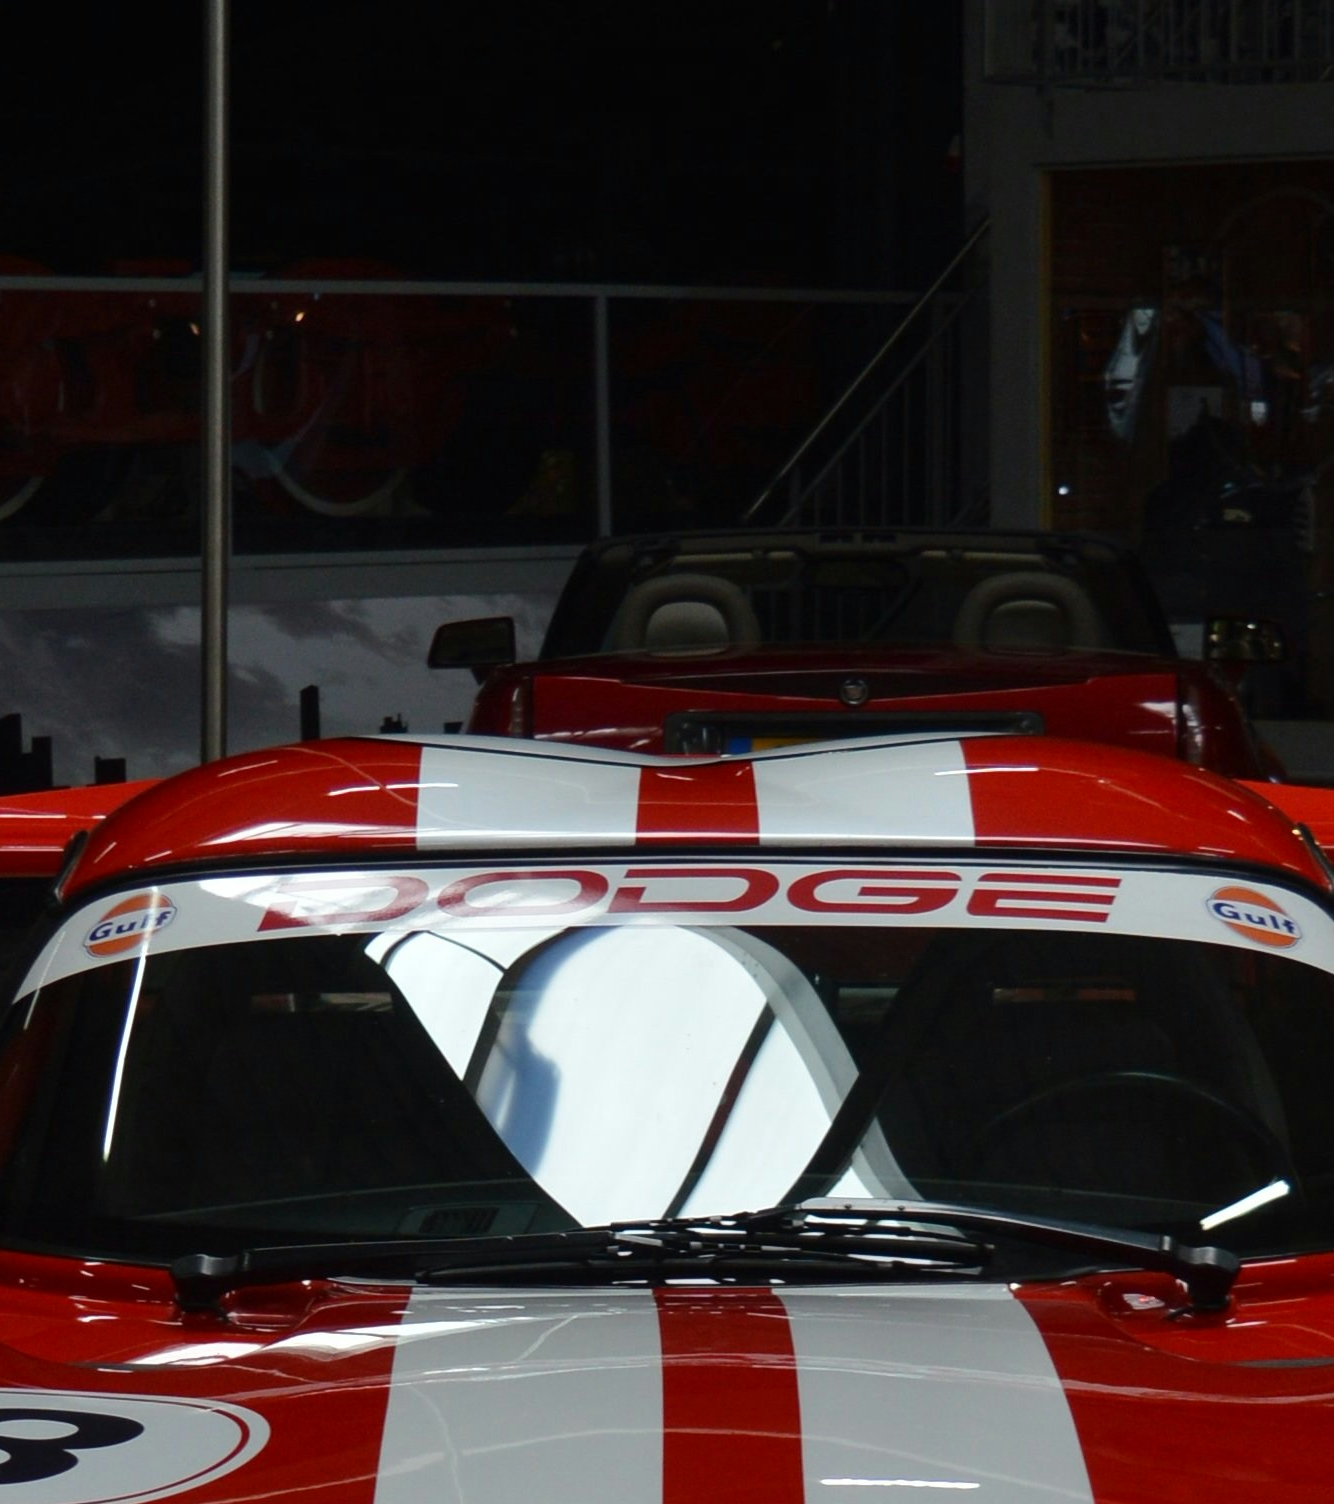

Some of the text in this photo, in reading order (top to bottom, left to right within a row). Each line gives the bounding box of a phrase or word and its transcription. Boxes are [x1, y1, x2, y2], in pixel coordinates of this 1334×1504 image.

[257, 868, 1123, 933] DODGE
[89, 910, 172, 942] Gulf
[1212, 902, 1296, 934] Gulf
